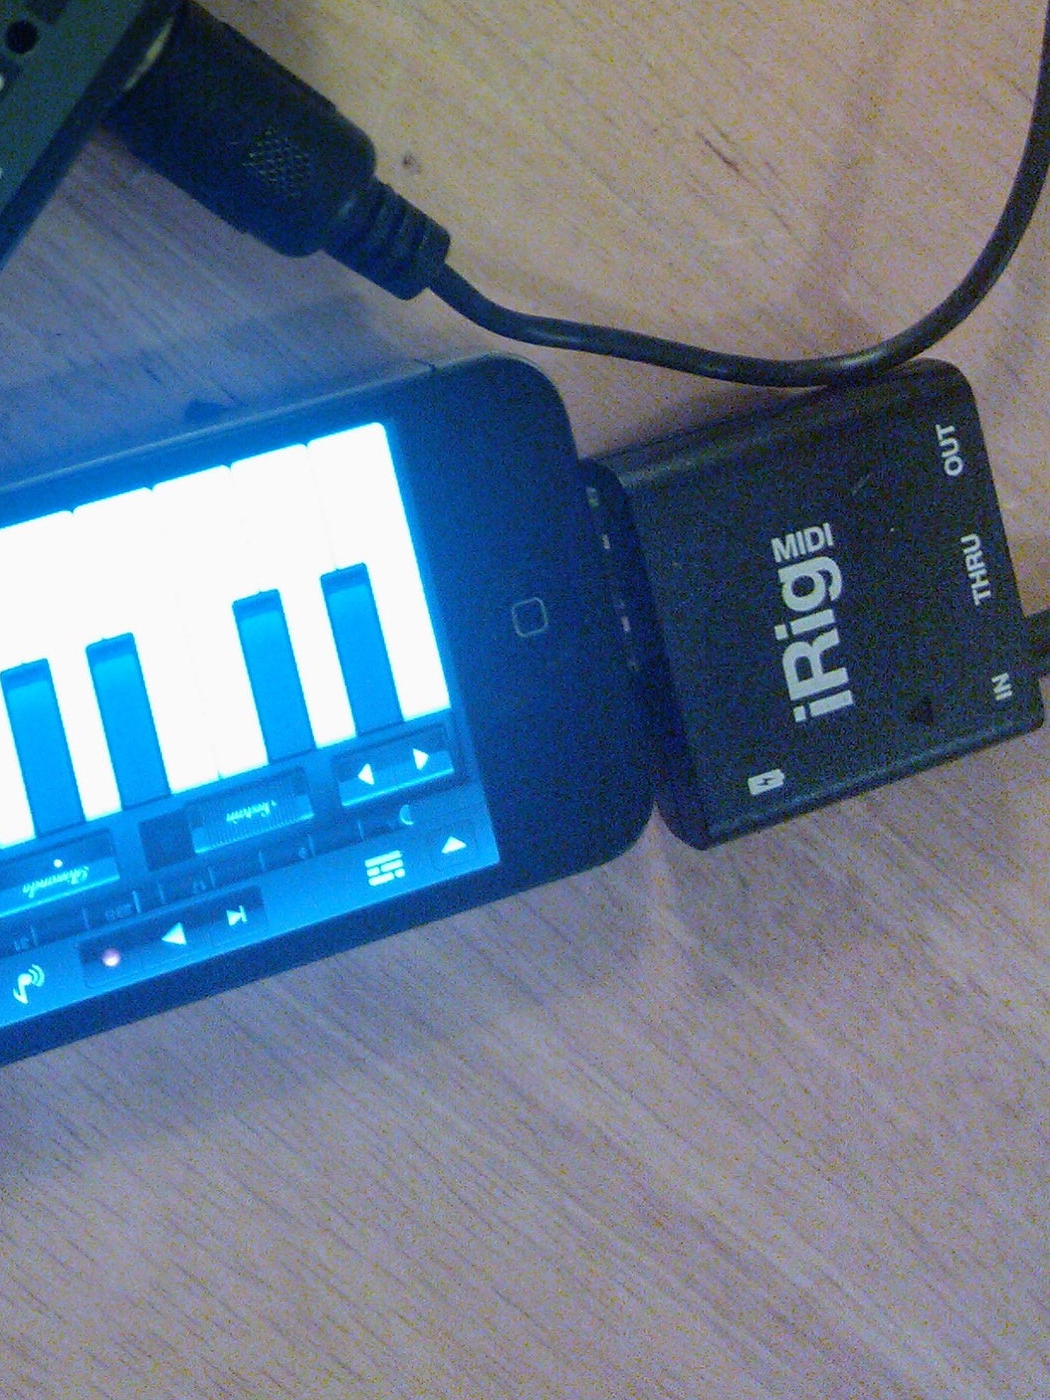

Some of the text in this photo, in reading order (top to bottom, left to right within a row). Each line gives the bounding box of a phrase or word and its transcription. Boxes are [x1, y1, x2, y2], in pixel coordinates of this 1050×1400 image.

[935, 423, 963, 477] OUT
[960, 534, 991, 606] THRU
[771, 522, 854, 723] iRig MIDI
[991, 672, 1012, 700] IN
